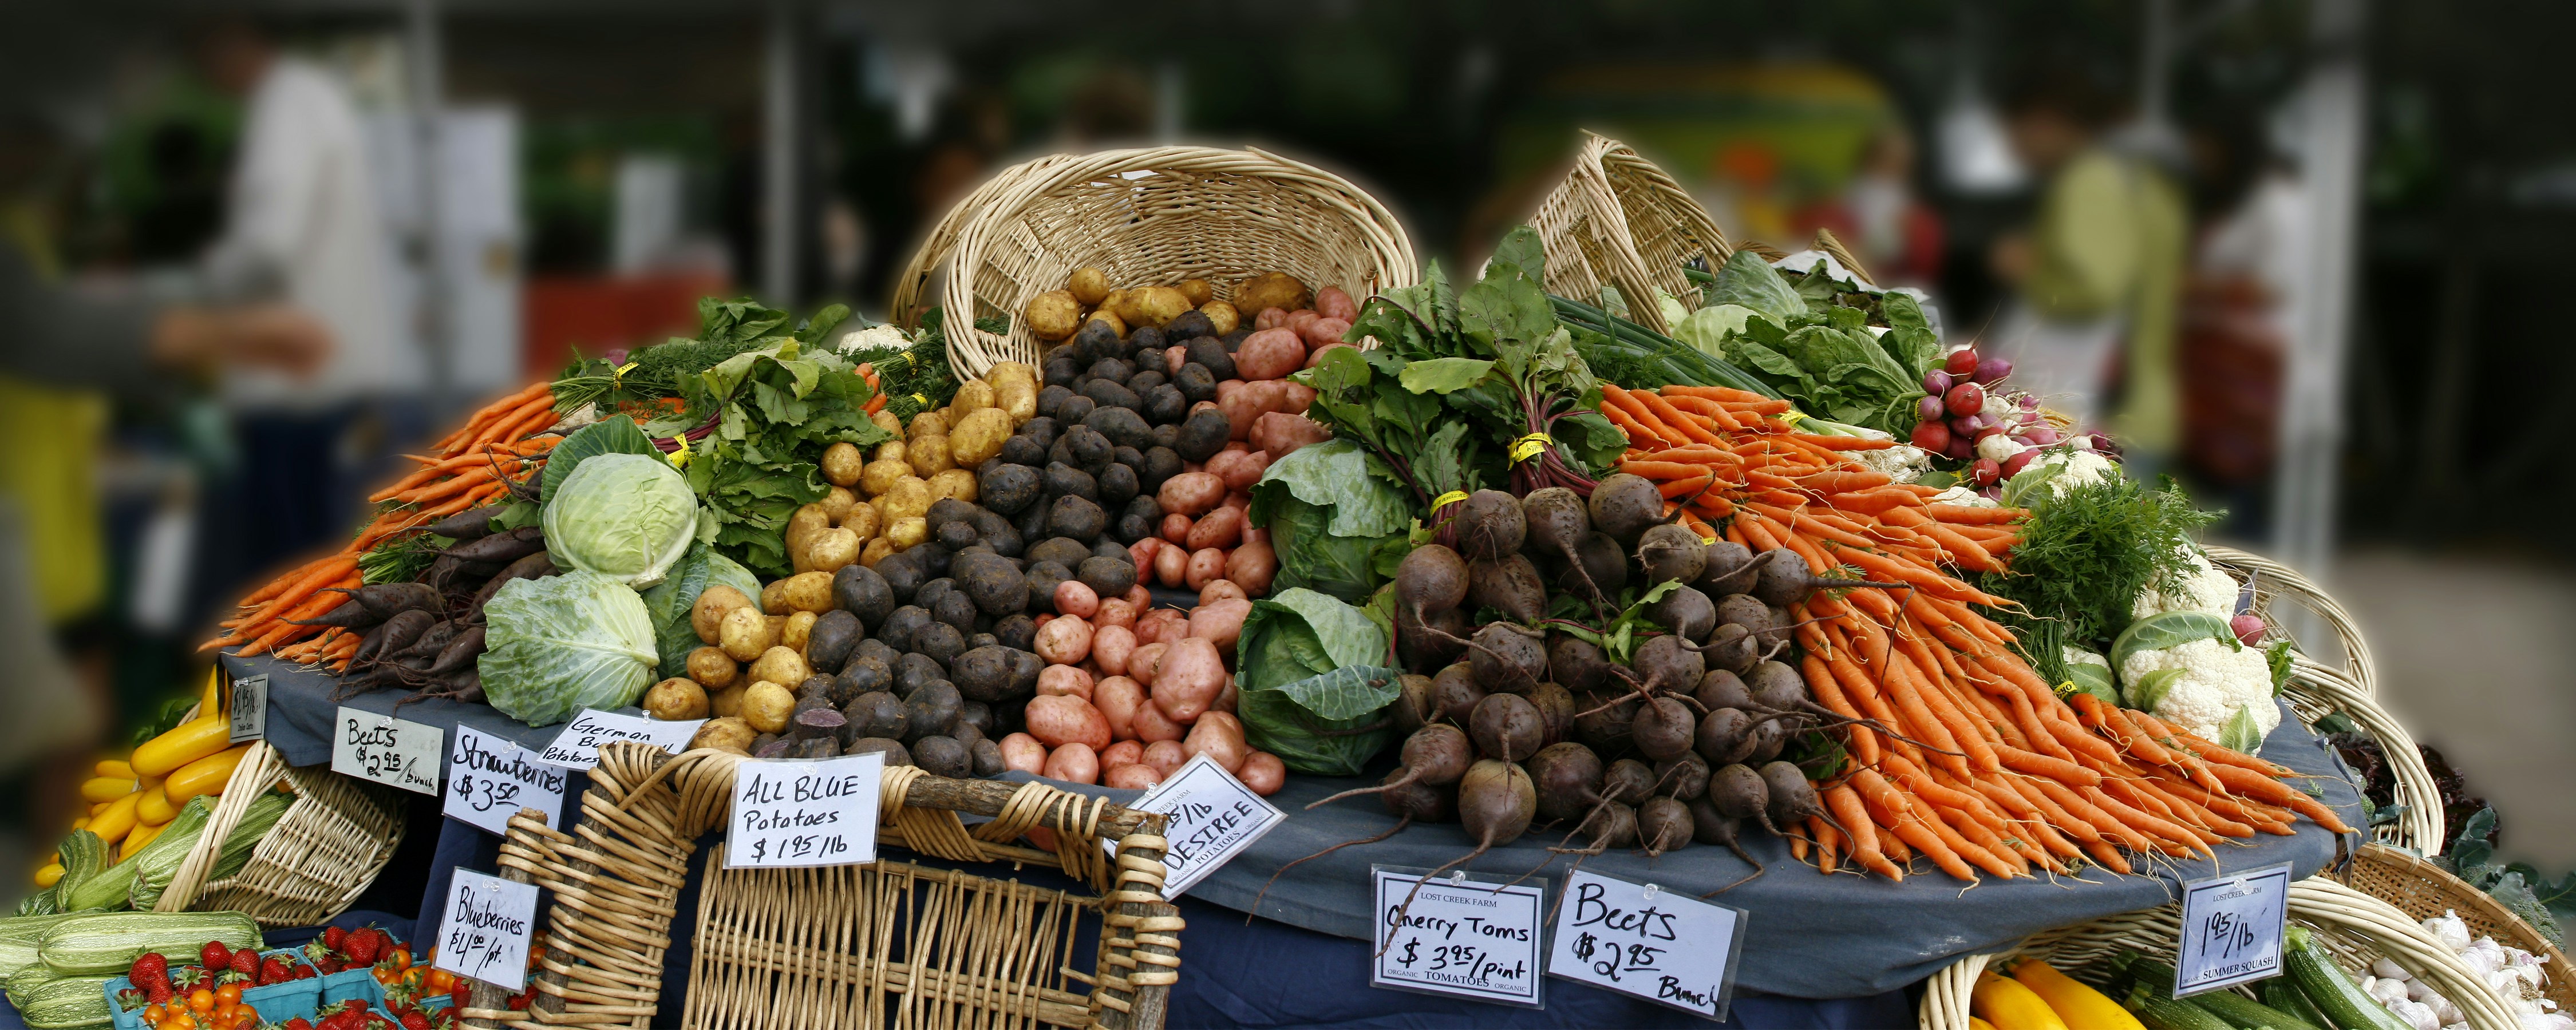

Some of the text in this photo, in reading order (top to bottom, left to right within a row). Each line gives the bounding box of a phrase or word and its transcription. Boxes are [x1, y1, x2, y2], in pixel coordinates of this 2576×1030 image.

[348, 718, 398, 747] Beets
[571, 717, 651, 741] German
[453, 734, 564, 795] Strawberries
[742, 773, 859, 805] ALL BLUE
[1173, 789, 1191, 802] FARM
[744, 809, 839, 832] Potatoes
[1162, 801, 1253, 871] DESIREE
[1172, 814, 1266, 882] ORGANIC POTATOES ORGANIC
[455, 885, 526, 936] Blueberries
[1421, 892, 1498, 908] LOST CREEK FARM
[1571, 882, 1677, 941] Beets
[2213, 893, 2227, 902] LOST
[1464, 917, 1528, 942] Toms
[1388, 969, 1527, 992] ORGANIC TOMATOES ORGANIC
[2182, 956, 2274, 984] ORGANIC SUMMER SQUASH
